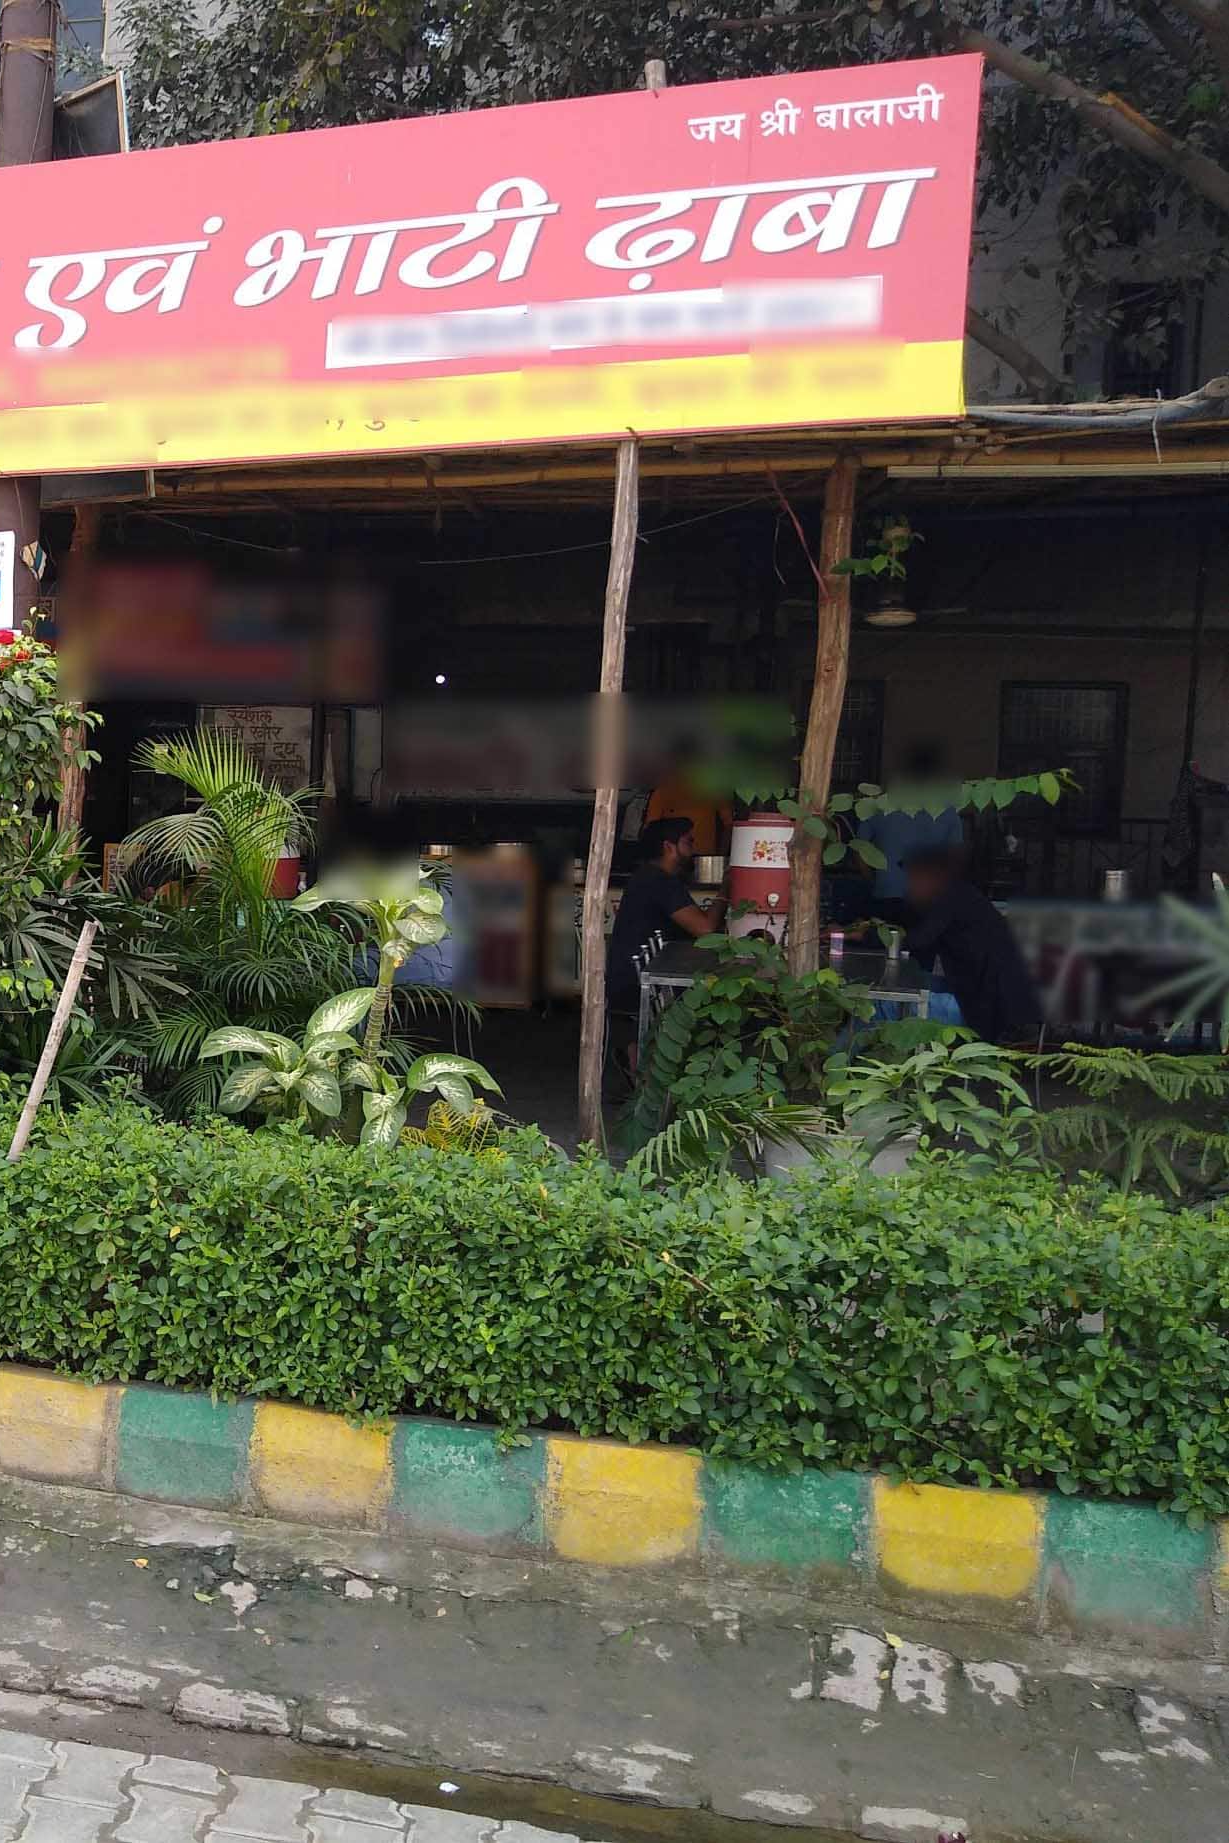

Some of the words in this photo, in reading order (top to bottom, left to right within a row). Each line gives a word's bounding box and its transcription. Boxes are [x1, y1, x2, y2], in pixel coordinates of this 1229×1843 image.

[687, 113, 746, 144] जय
[759, 97, 802, 138] श्री
[813, 82, 945, 131] बालाजी
[14, 215, 225, 352] एवं
[233, 176, 560, 308] भाटी
[584, 167, 937, 292] ढ़ाबा
